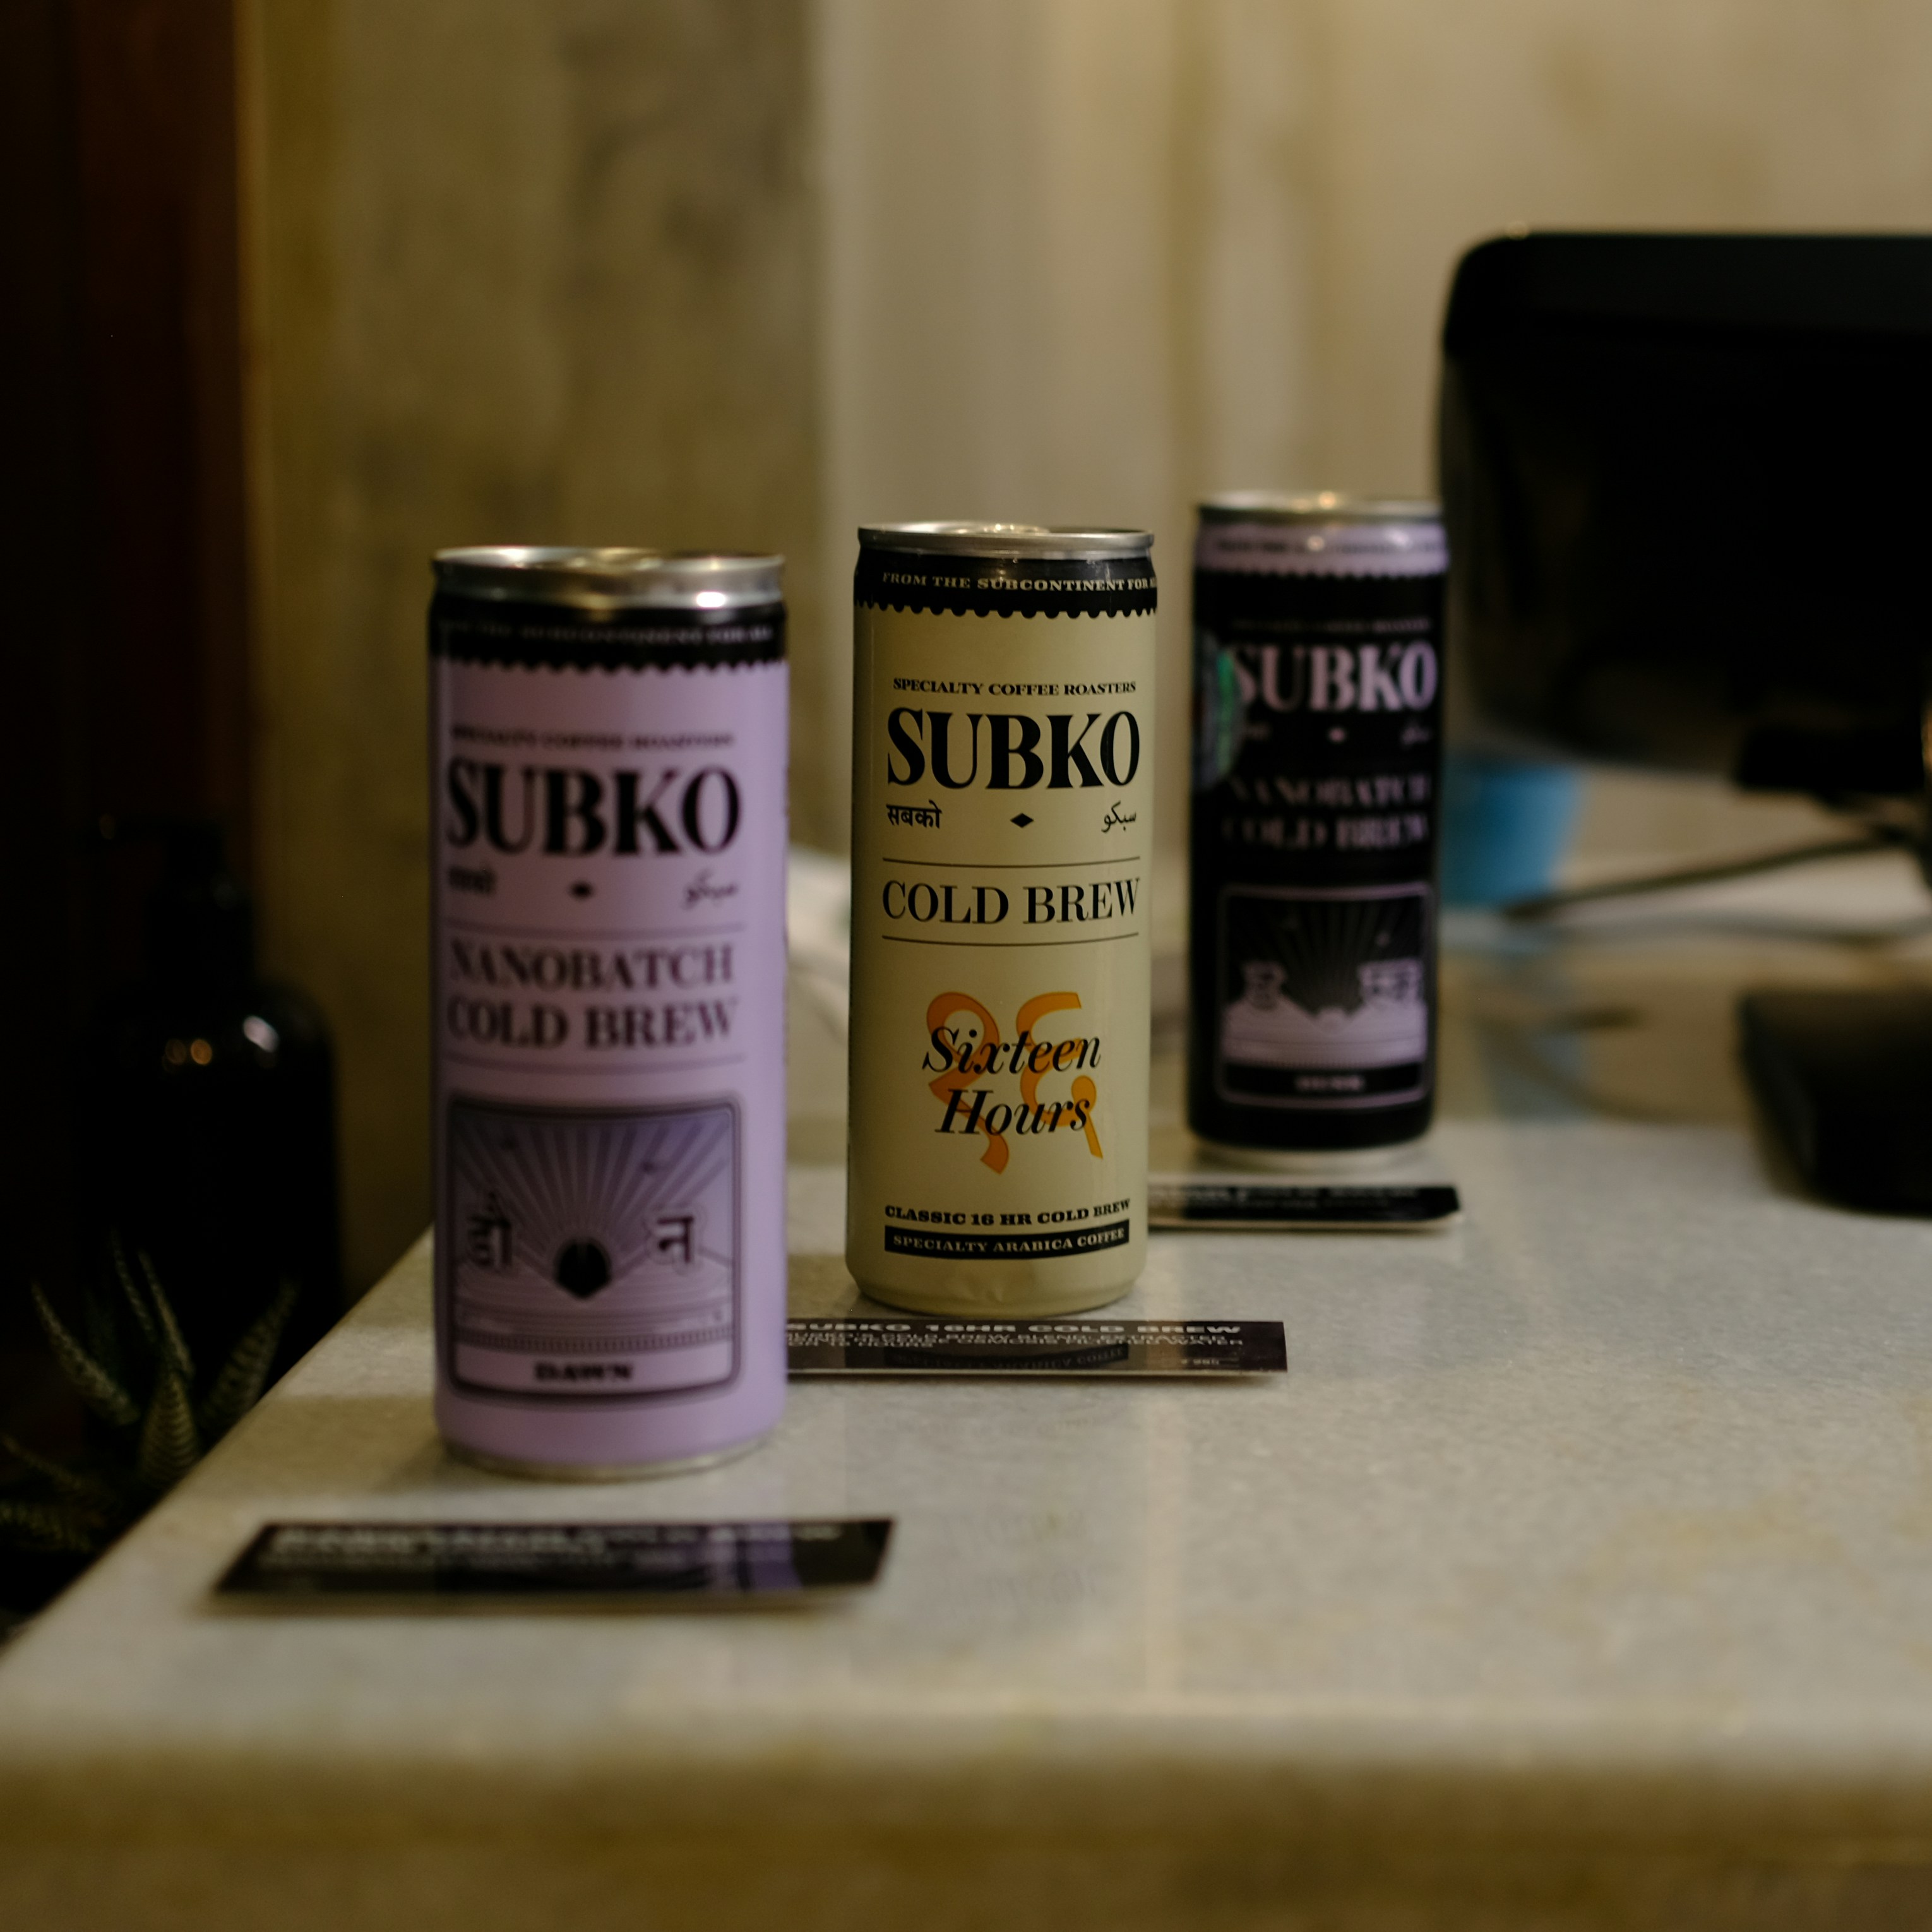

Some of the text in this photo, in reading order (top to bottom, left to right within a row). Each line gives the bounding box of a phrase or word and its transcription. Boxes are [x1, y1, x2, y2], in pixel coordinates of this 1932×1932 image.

[883, 571, 926, 587] FROM
[933, 576, 970, 589] THE
[977, 578, 1124, 592] SUBCONTINENT
[1127, 577, 1148, 590] FOR
[893, 677, 1136, 695] SPECIALTY COFFEE ROASTERS
[1229, 640, 1438, 712] SUBKO
[888, 707, 1140, 789] SUBKO
[446, 756, 741, 856] SUBKO
[886, 800, 942, 828] सबको
[882, 877, 1140, 924] COLD BREW
[448, 939, 734, 991] NANOBATCH
[446, 994, 737, 1050] COLD BREW
[922, 1026, 1101, 1074] Sixteen
[934, 1088, 1090, 1135] Hours
[885, 1198, 1131, 1225] CLASSIC 16 HR COLD BREW
[893, 1228, 1125, 1253] SPECIALTY ARABICA COFFEE
[787, 1323, 910, 1332] SUBKO
